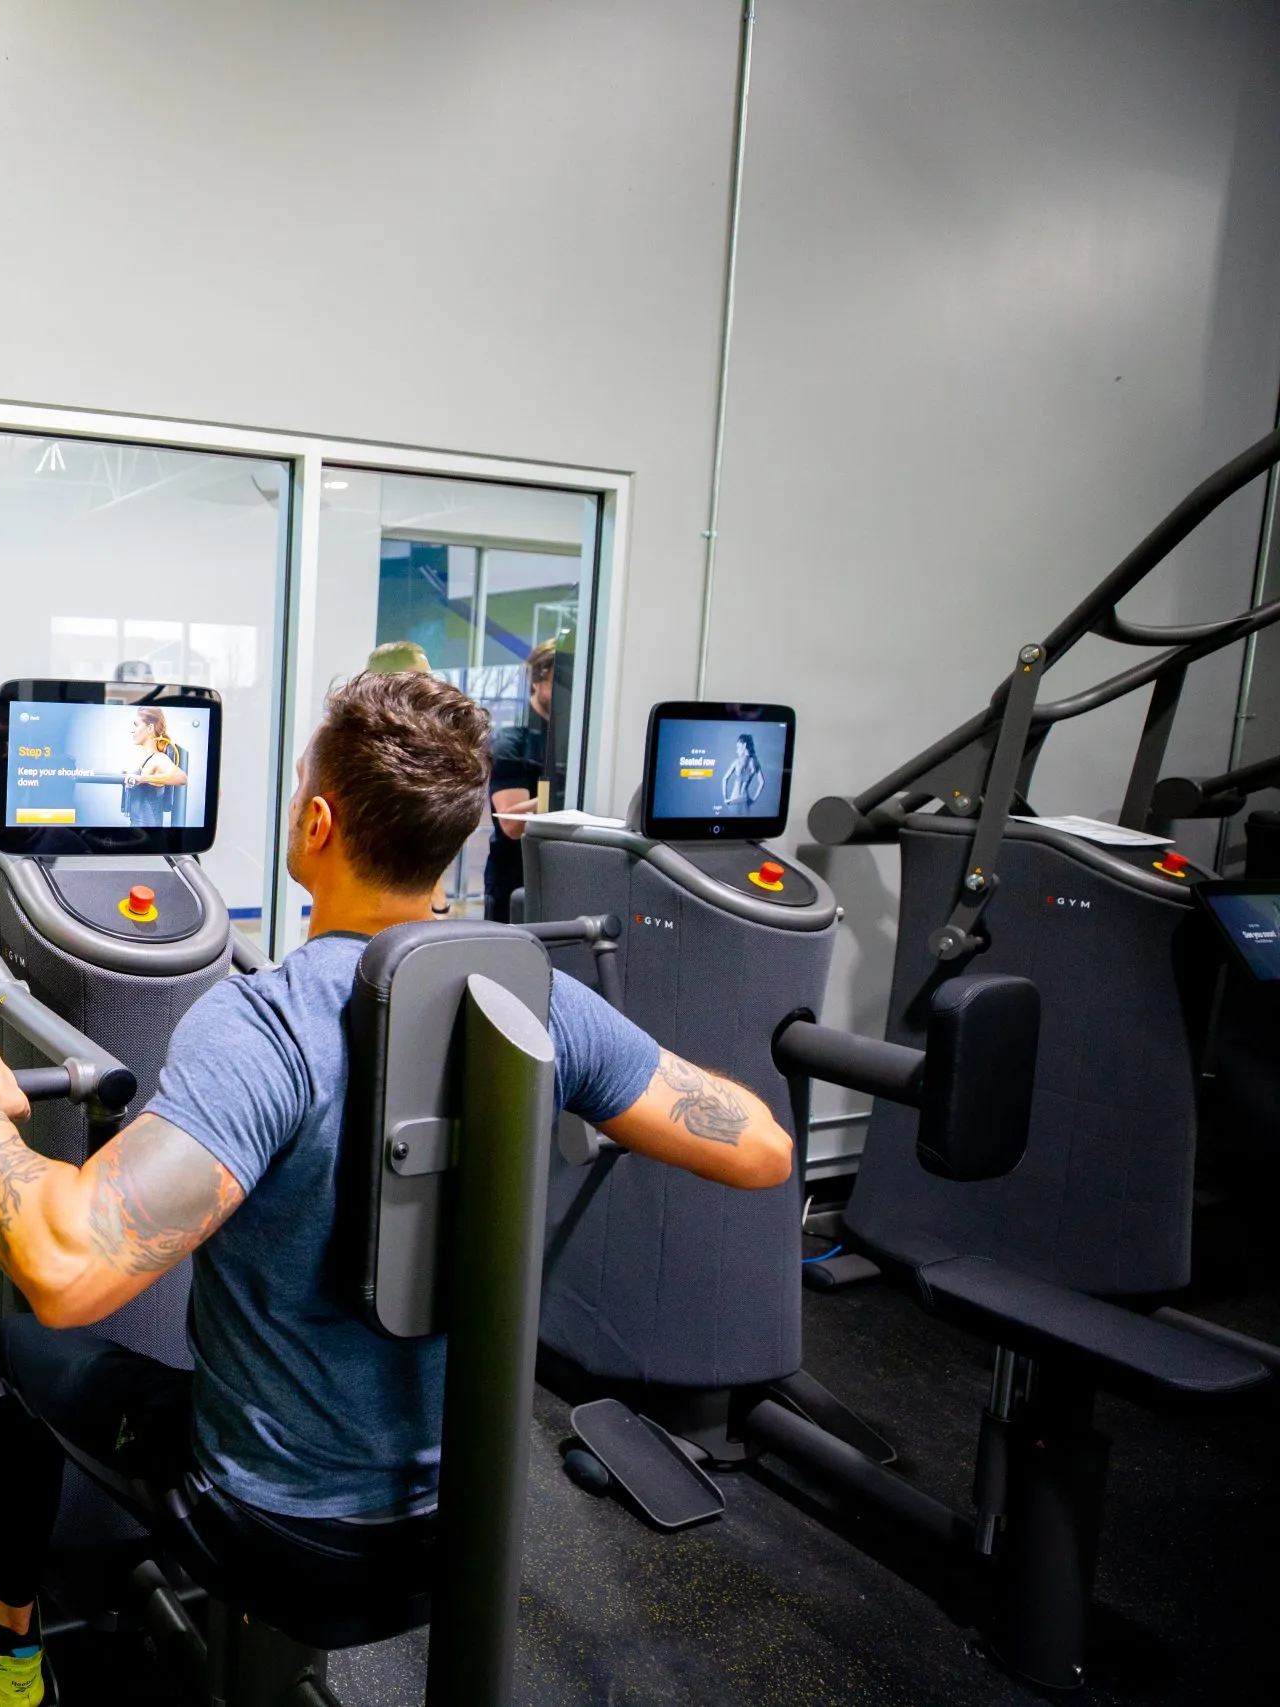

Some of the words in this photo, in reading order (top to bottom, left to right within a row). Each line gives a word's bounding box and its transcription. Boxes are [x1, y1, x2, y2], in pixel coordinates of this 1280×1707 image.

[19, 746, 42, 759] Step
[44, 746, 51, 757] 3
[680, 757, 703, 766] Seated
[18, 767, 38, 777] Keep
[40, 768, 56, 777] your
[58, 767, 95, 777] shoulders
[18, 778, 39, 787] down
[634, 914, 674, 929] EGYM
